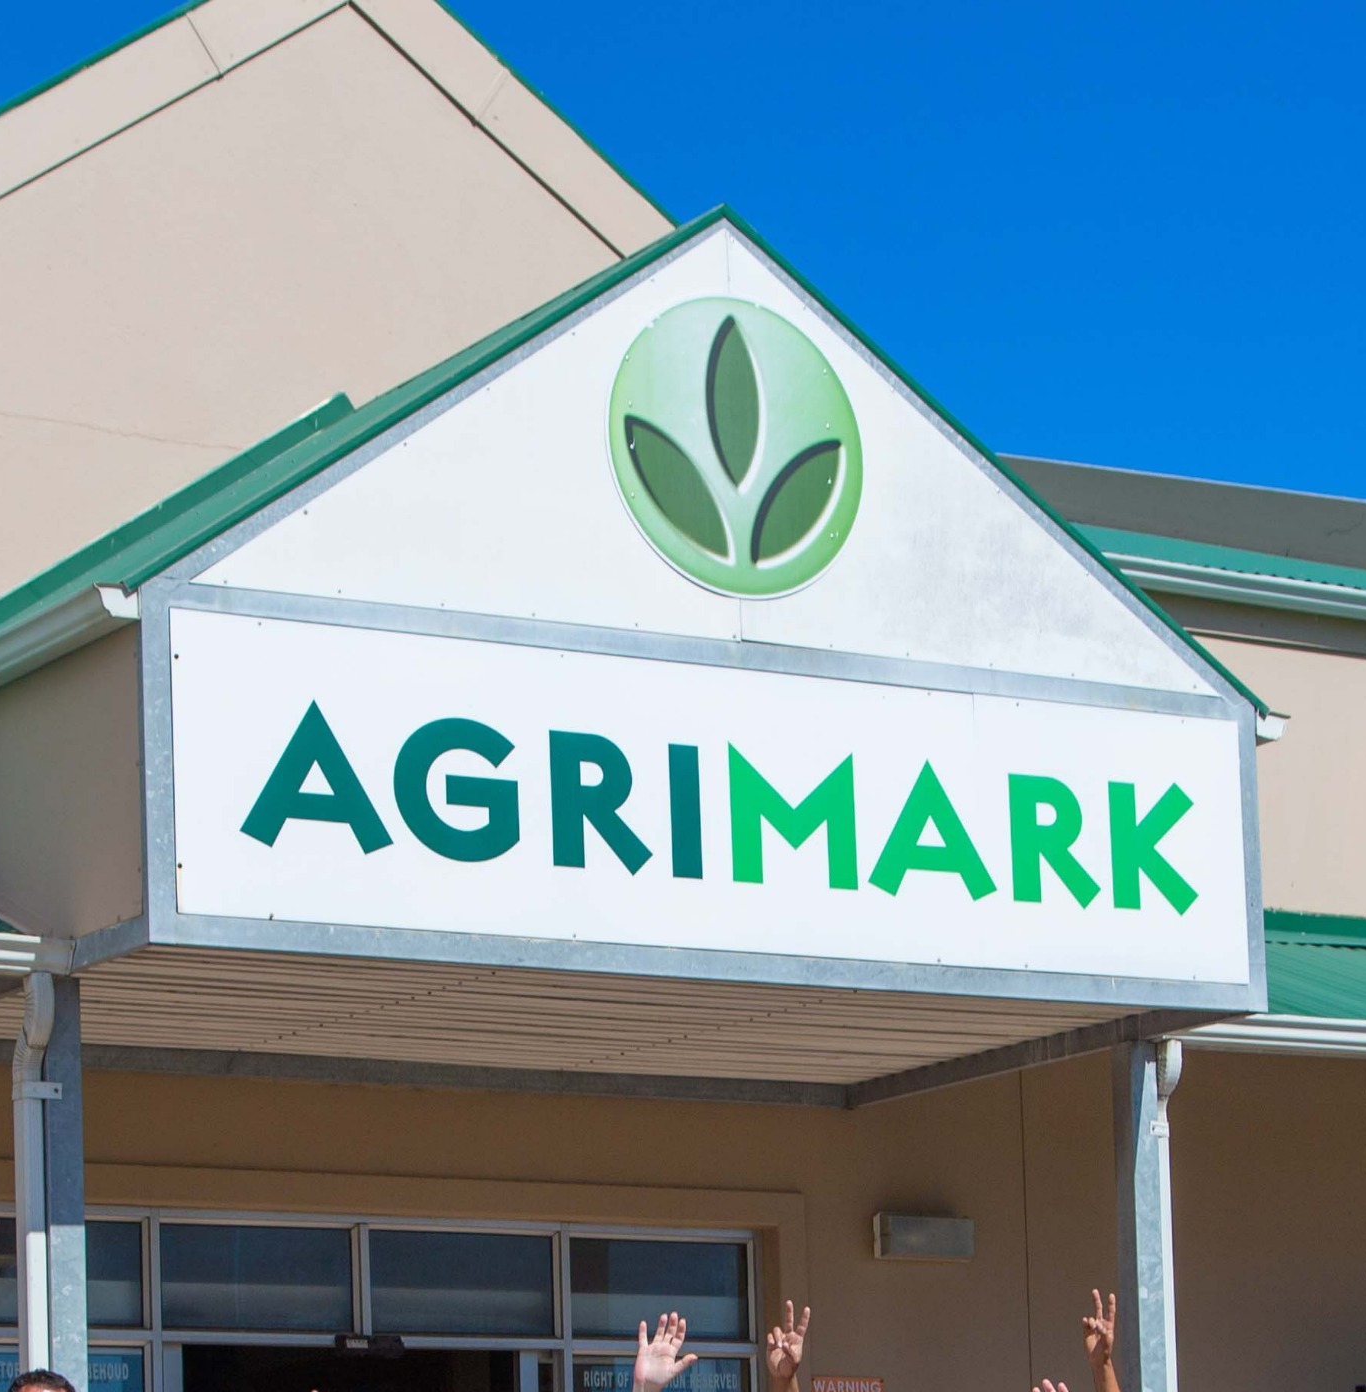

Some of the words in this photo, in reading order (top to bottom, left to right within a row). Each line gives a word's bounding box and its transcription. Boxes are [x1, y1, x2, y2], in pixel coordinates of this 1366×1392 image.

[240, 698, 1199, 916] AGRIMARK
[584, 1371, 613, 1388] RIGHT
[617, 1371, 629, 1388] OF
